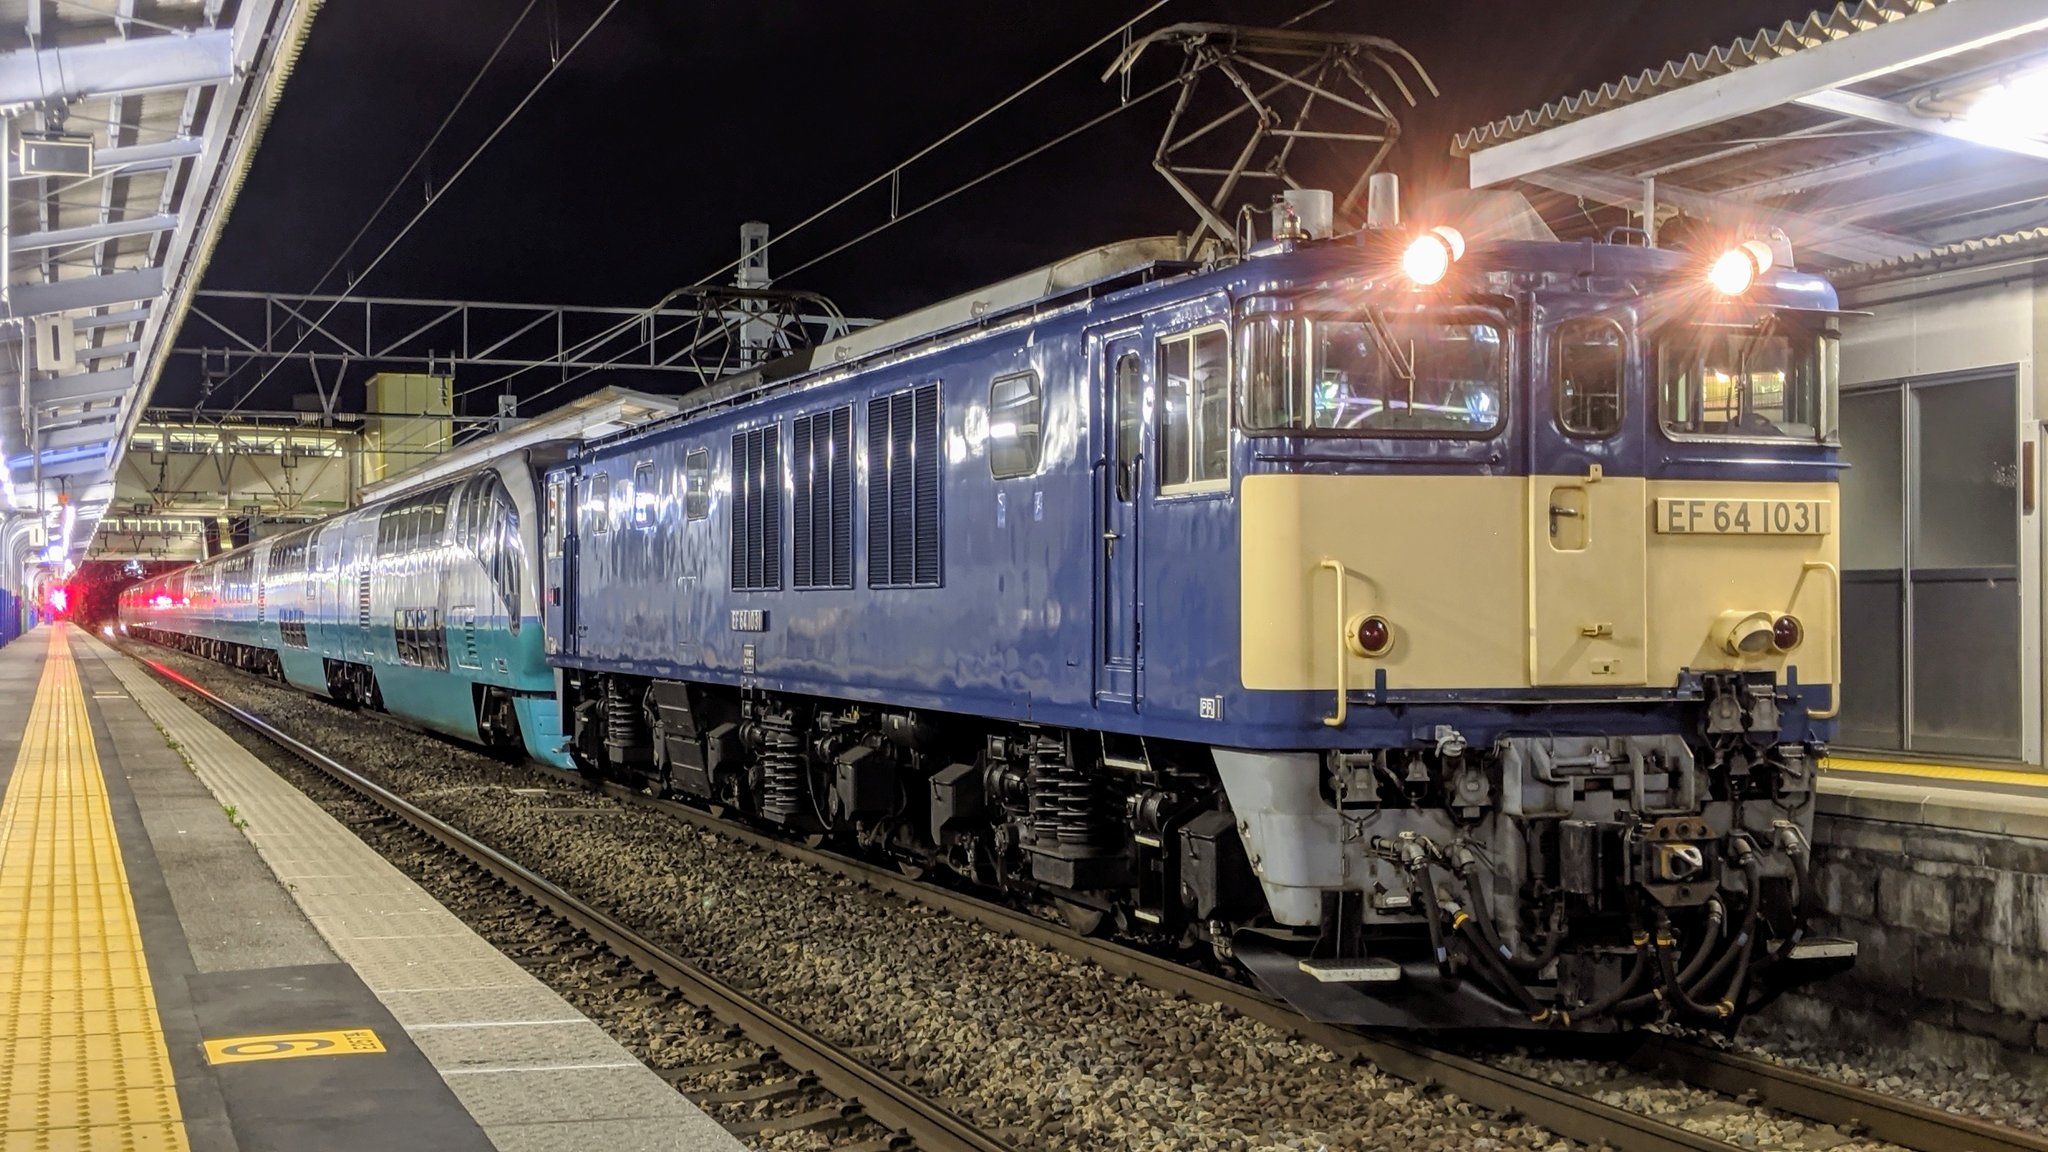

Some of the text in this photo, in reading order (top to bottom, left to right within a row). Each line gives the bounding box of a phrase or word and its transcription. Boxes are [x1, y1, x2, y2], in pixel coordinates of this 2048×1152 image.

[1668, 501, 1820, 533] EF 64 1031
